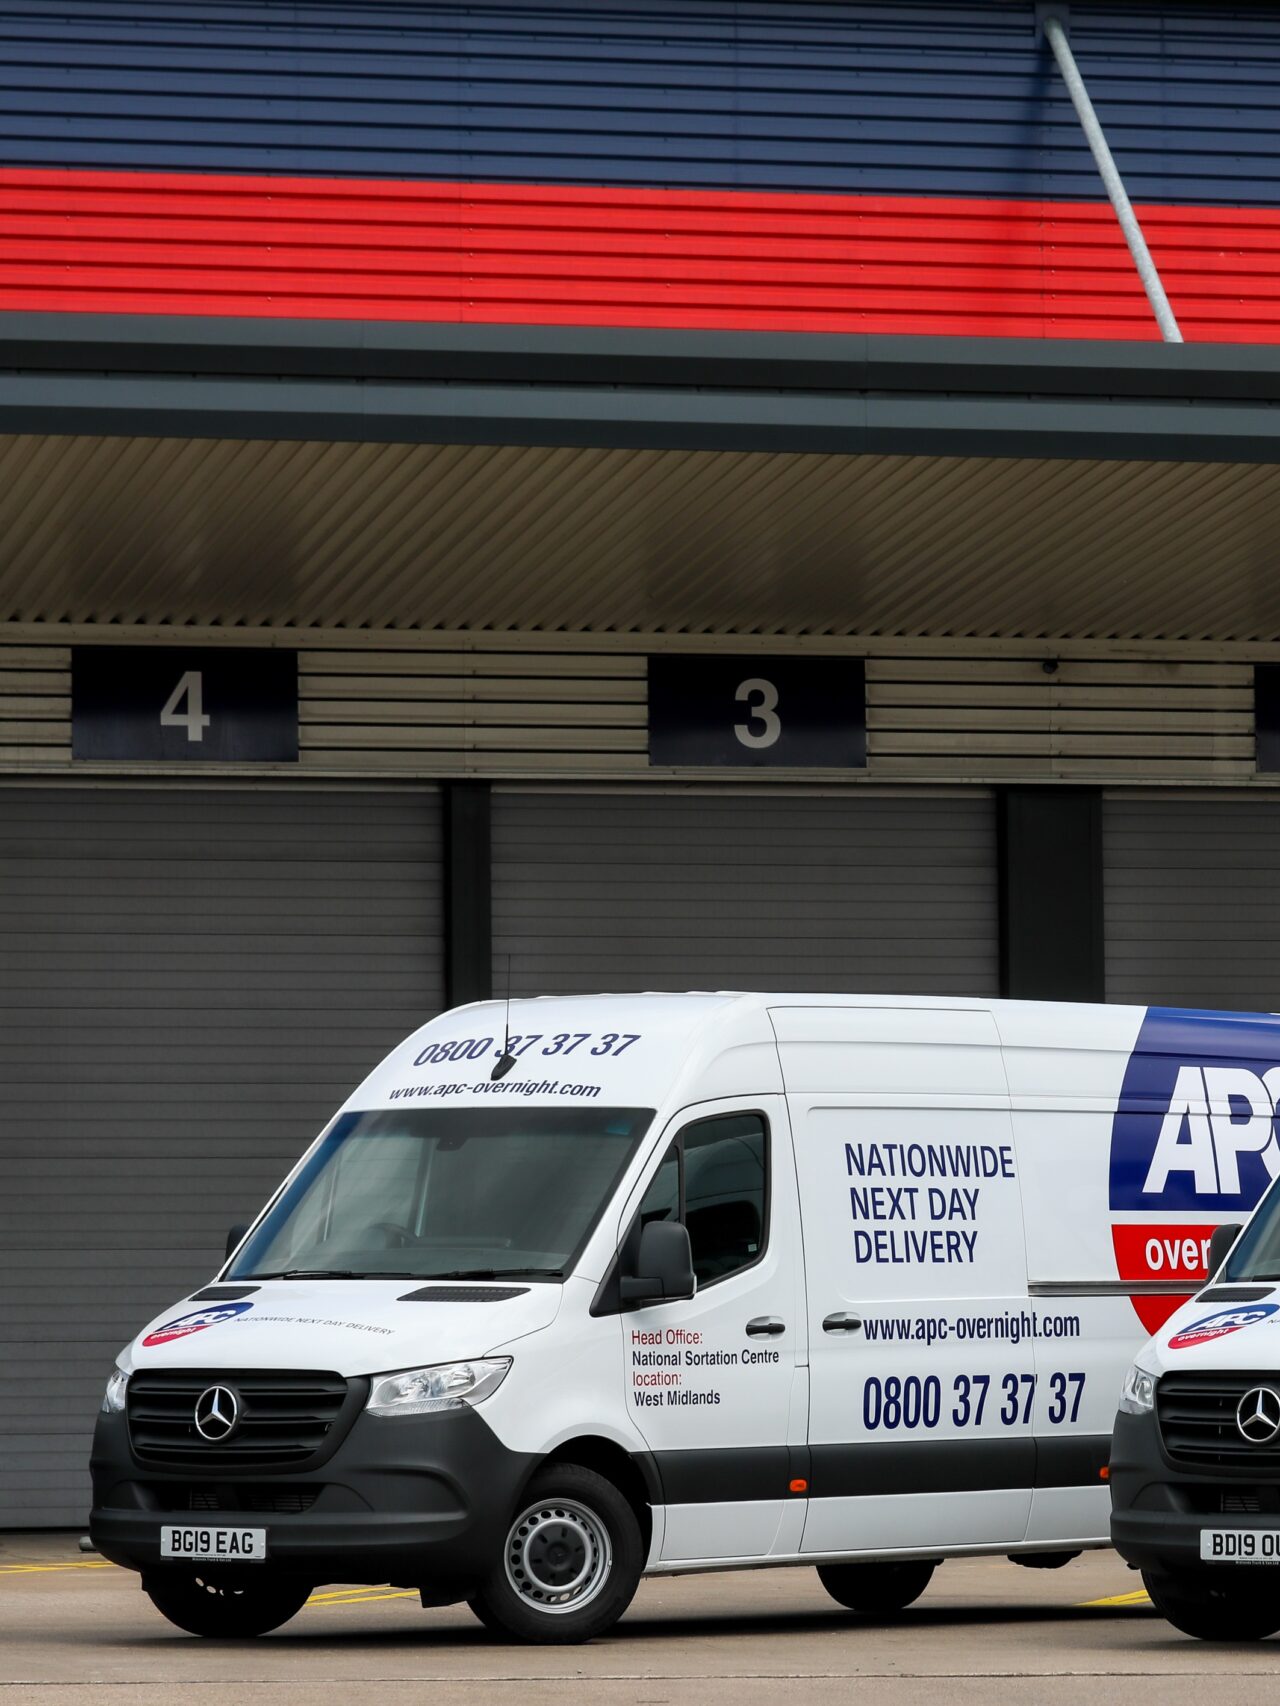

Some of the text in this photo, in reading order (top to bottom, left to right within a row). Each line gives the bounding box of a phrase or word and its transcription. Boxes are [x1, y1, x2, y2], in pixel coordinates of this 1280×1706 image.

[158, 670, 212, 742] 4
[733, 677, 782, 749] 3
[413, 1033, 641, 1067] 0800 37 37 37
[389, 1079, 601, 1100] www.apc-overnight.com
[844, 1143, 1016, 1178] NATIONWIDE
[849, 1187, 980, 1220] NEXT DAY
[854, 1230, 978, 1263] DELIVERY
[162, 1310, 237, 1330] APC
[346, 1322, 396, 1335] DELIVERY
[863, 1311, 1080, 1346] www.apc-overnight.com
[1187, 1311, 1266, 1332] APC
[631, 1329, 703, 1345] Head Office:
[1177, 1328, 1230, 1341] overnight
[632, 1349, 780, 1366] National Sortation Centre
[632, 1371, 682, 1386] location:
[634, 1389, 721, 1407] West Midlands
[863, 1372, 1086, 1430] 0800 37 37 37
[171, 1530, 254, 1554] BG19 EAG
[1212, 1533, 1256, 1556] BD19
